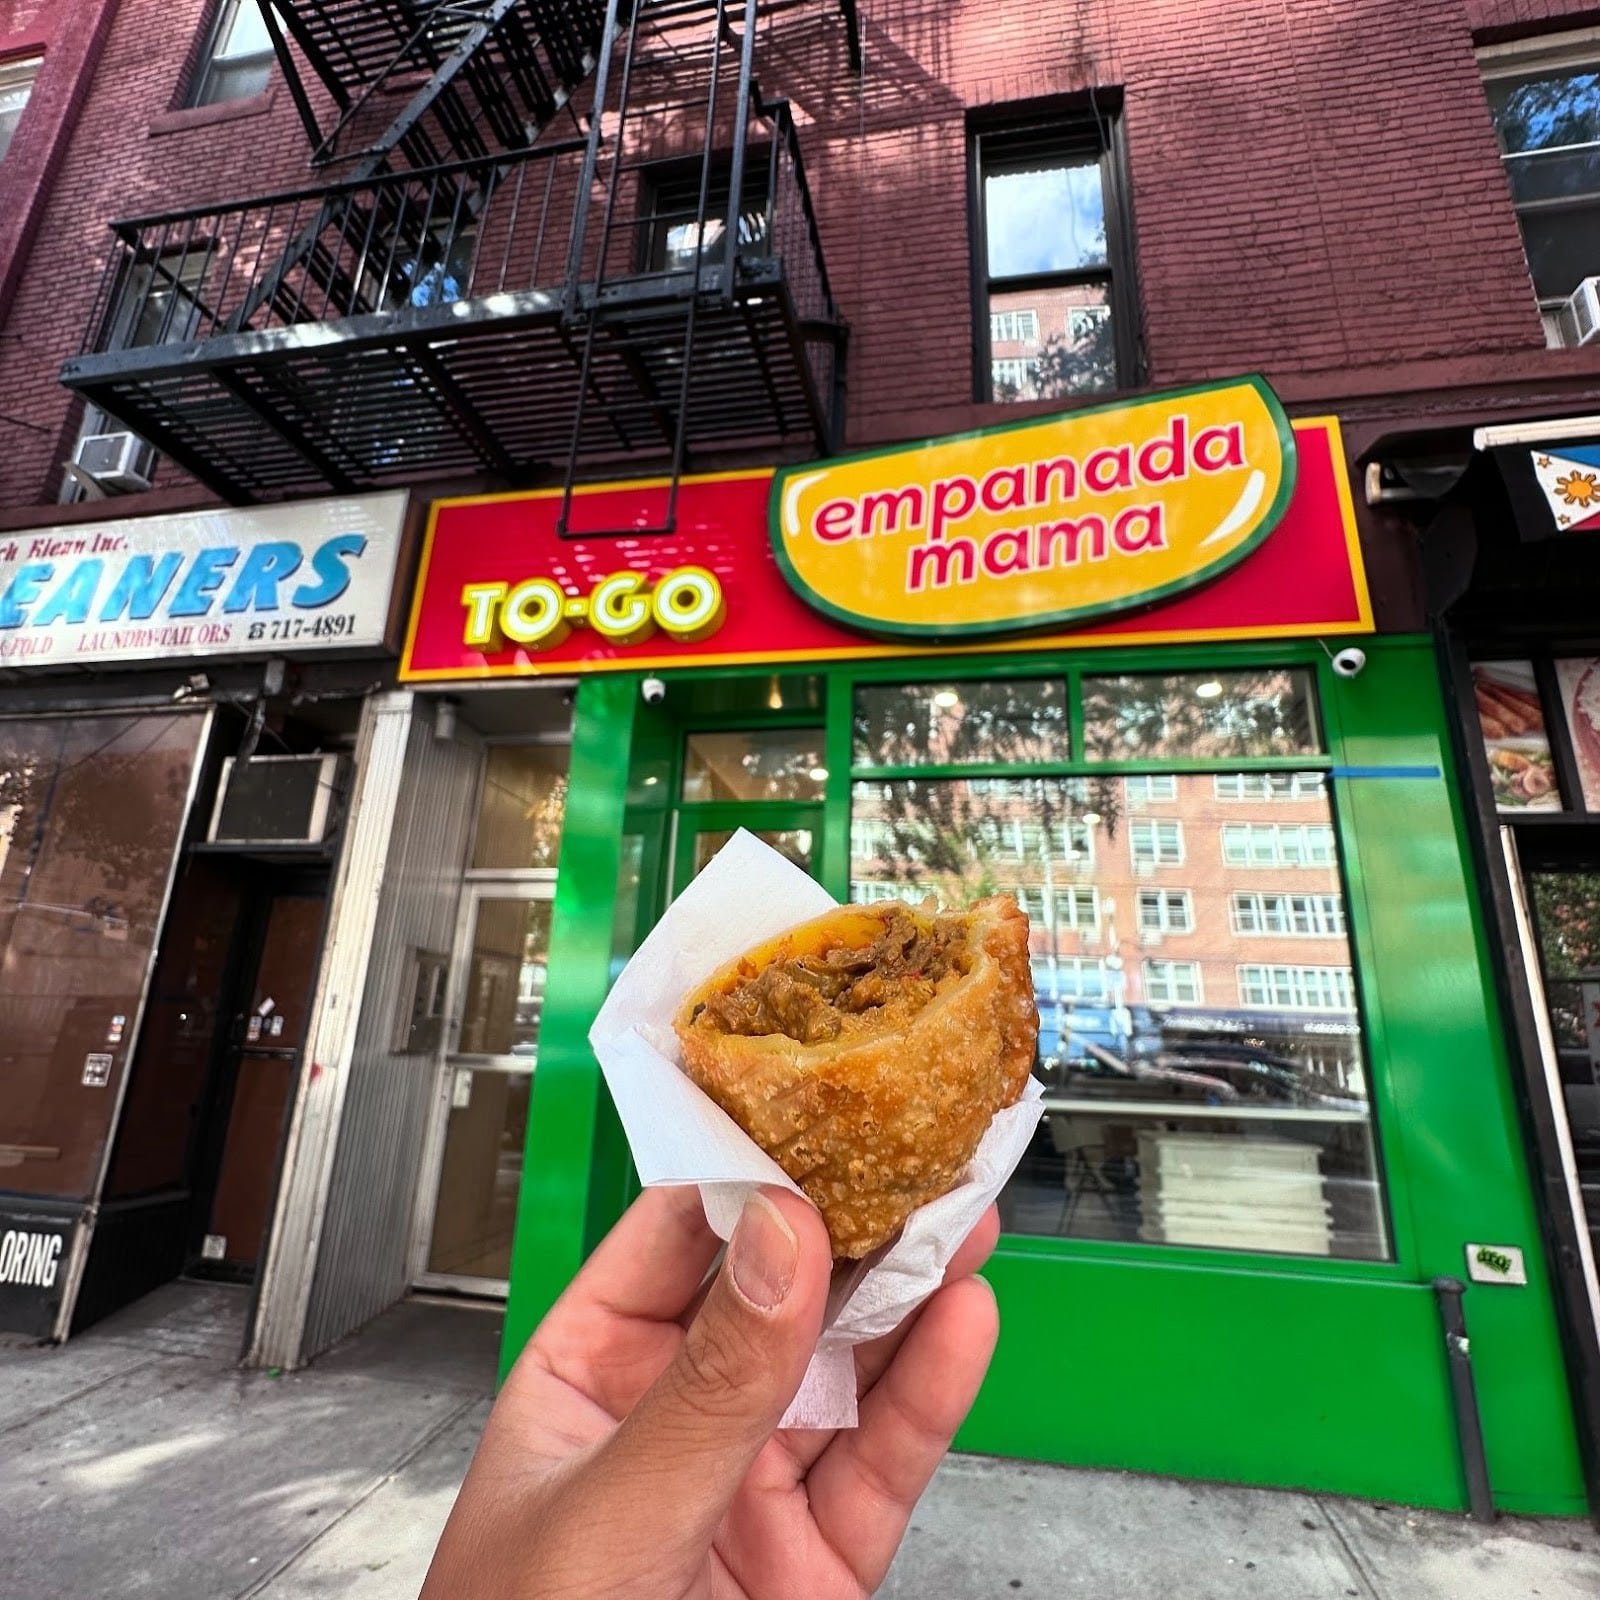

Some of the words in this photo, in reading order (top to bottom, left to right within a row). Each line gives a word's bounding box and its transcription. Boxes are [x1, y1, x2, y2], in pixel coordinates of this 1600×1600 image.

[813, 415, 1246, 543] empanada
[0, 533, 367, 630] EANERS
[92, 533, 128, 553] Inc.
[906, 503, 1166, 592] mama
[271, 614, 356, 640] 717-4891
[461, 565, 726, 652] TO-GO
[0, 1229, 63, 1288] ORING
